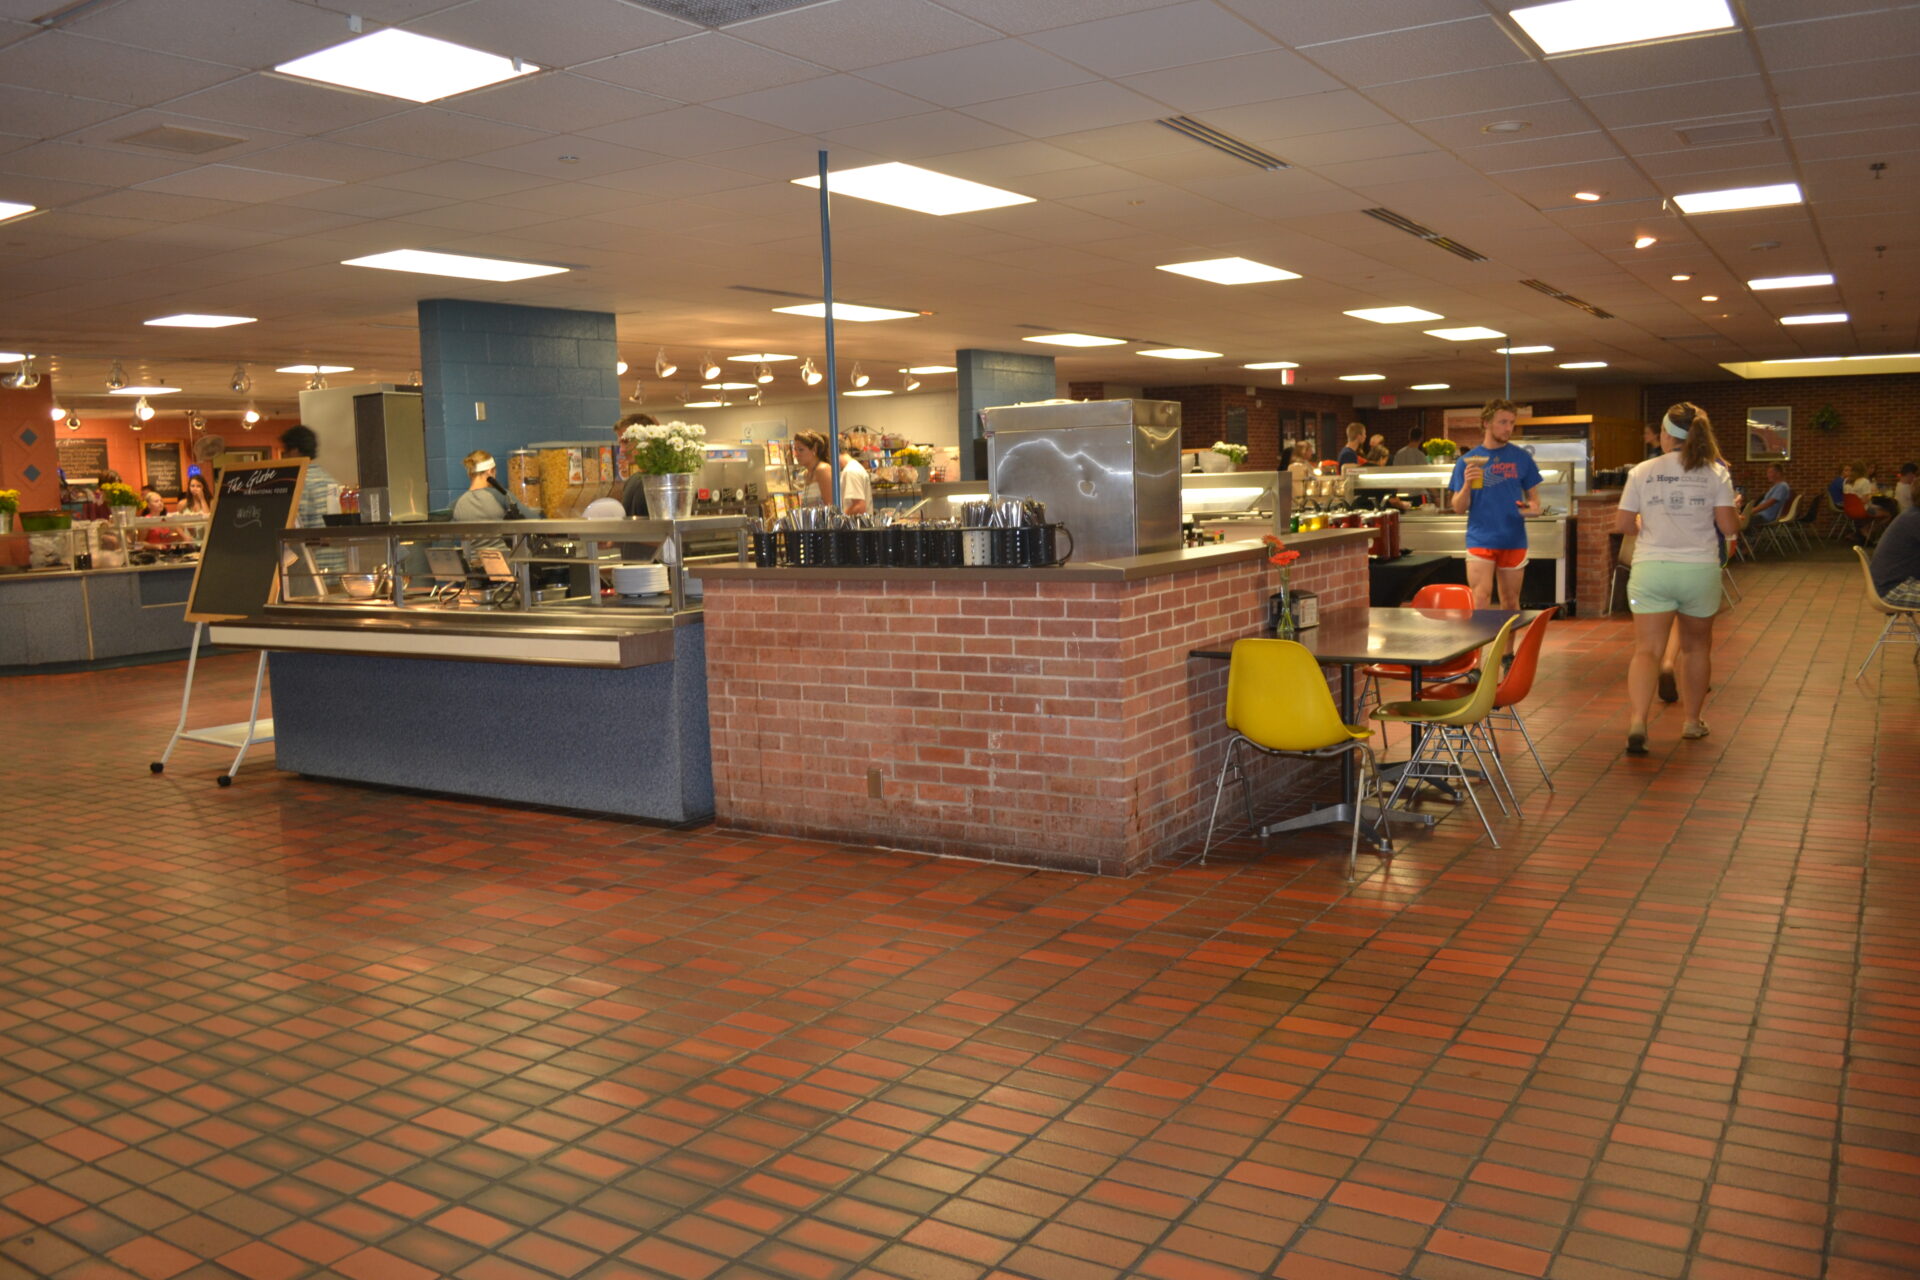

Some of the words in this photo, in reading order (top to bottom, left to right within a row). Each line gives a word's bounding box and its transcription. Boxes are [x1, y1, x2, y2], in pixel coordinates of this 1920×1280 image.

[227, 476, 244, 494] The
[246, 468, 277, 494] Globe
[1656, 474, 1680, 484] Hope
